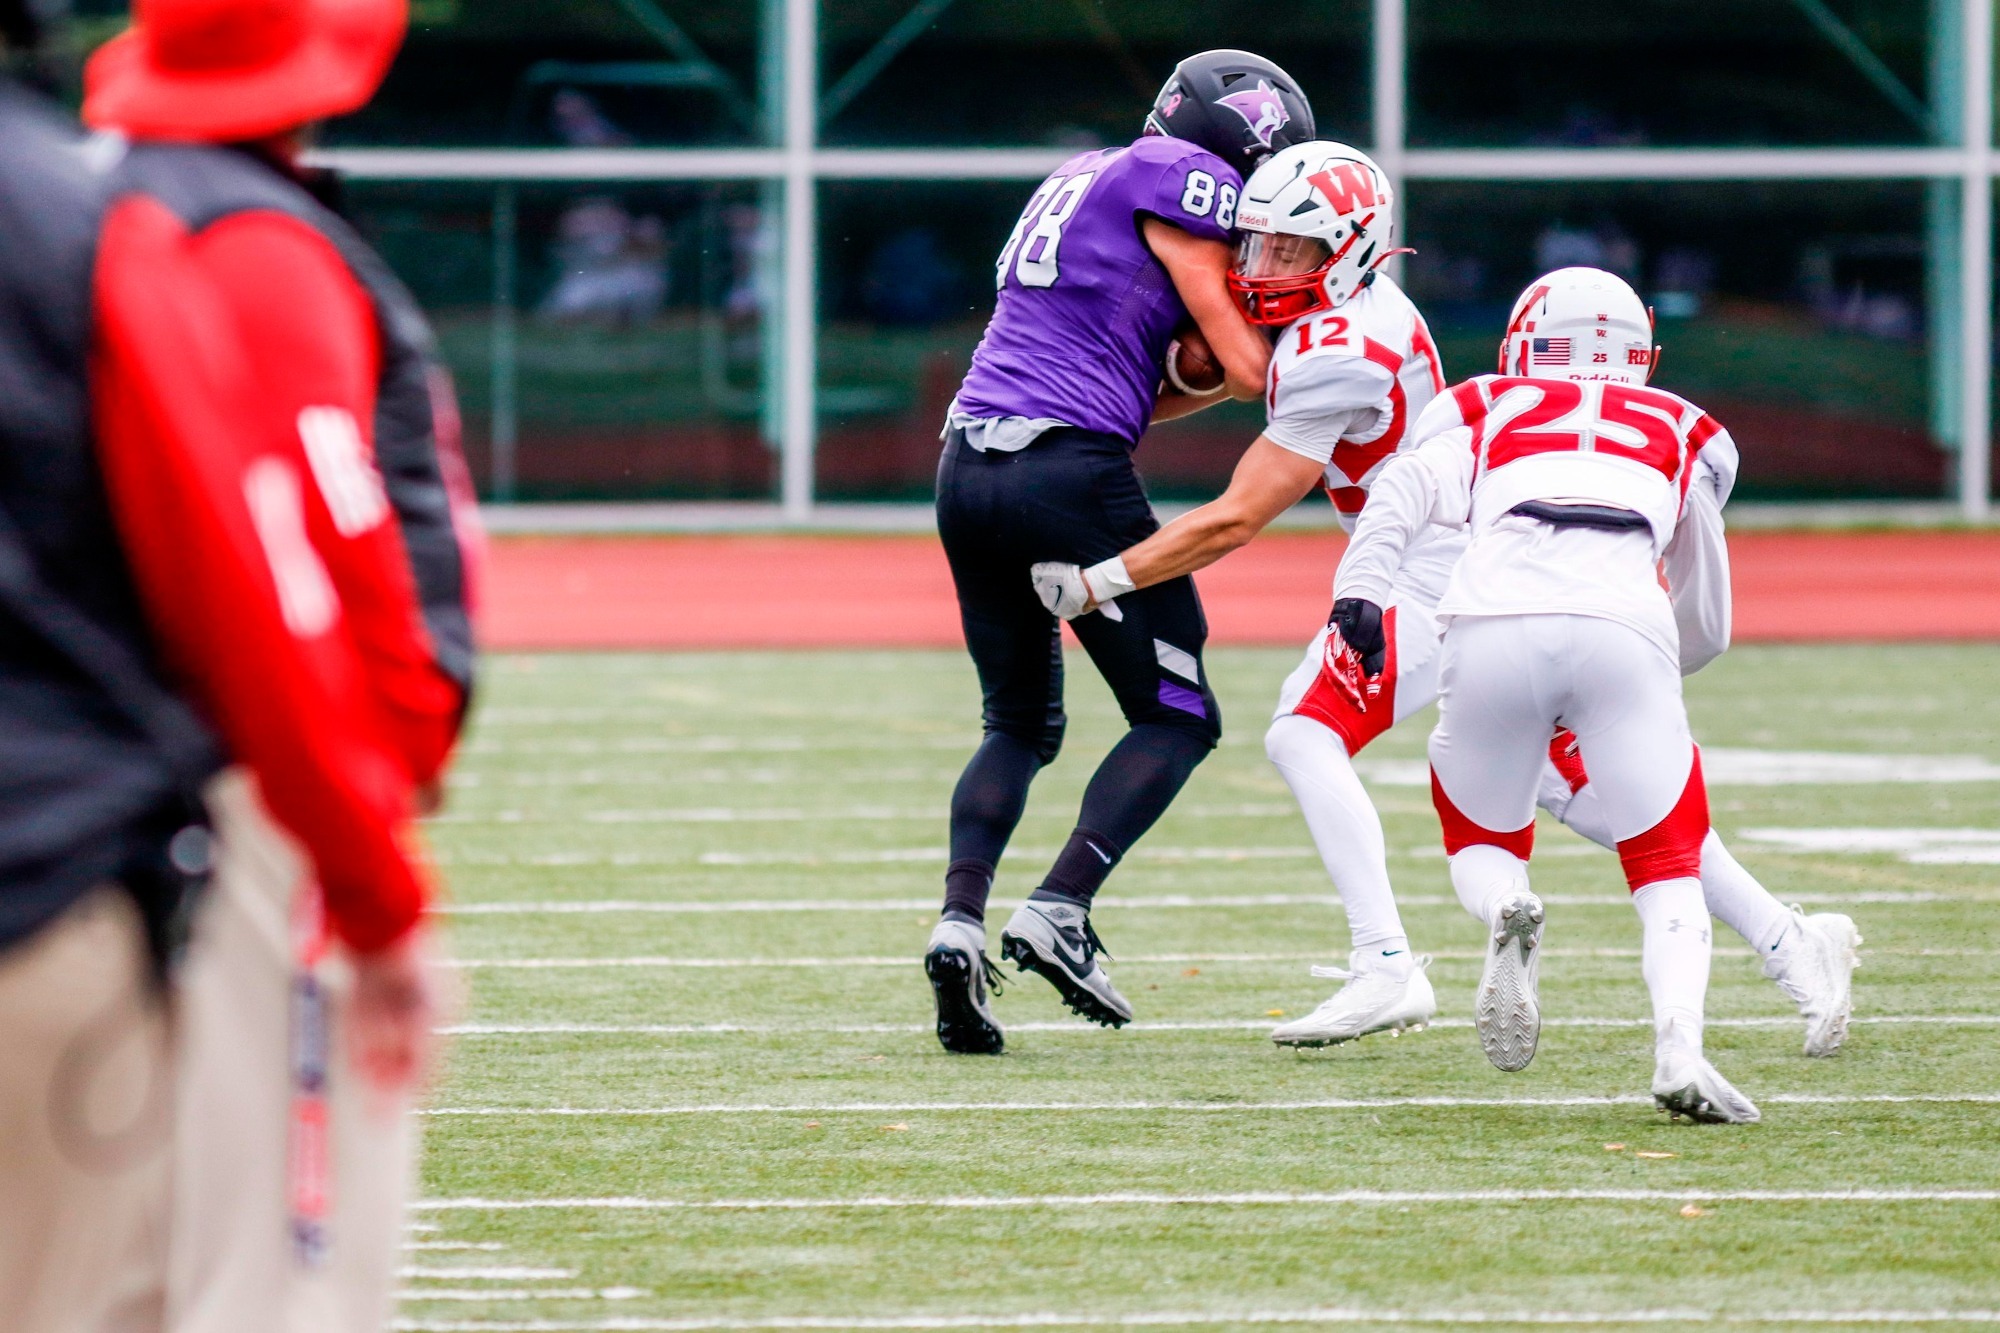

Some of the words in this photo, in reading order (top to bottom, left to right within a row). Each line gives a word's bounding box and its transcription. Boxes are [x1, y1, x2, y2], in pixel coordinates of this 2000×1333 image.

[1181, 169, 1238, 230] 88
[1238, 213, 1268, 227] Riddell
[995, 170, 1096, 291] 88
[1296, 316, 1350, 355] 12
[1592, 353, 1608, 363] 25
[1484, 376, 1686, 484] 25
